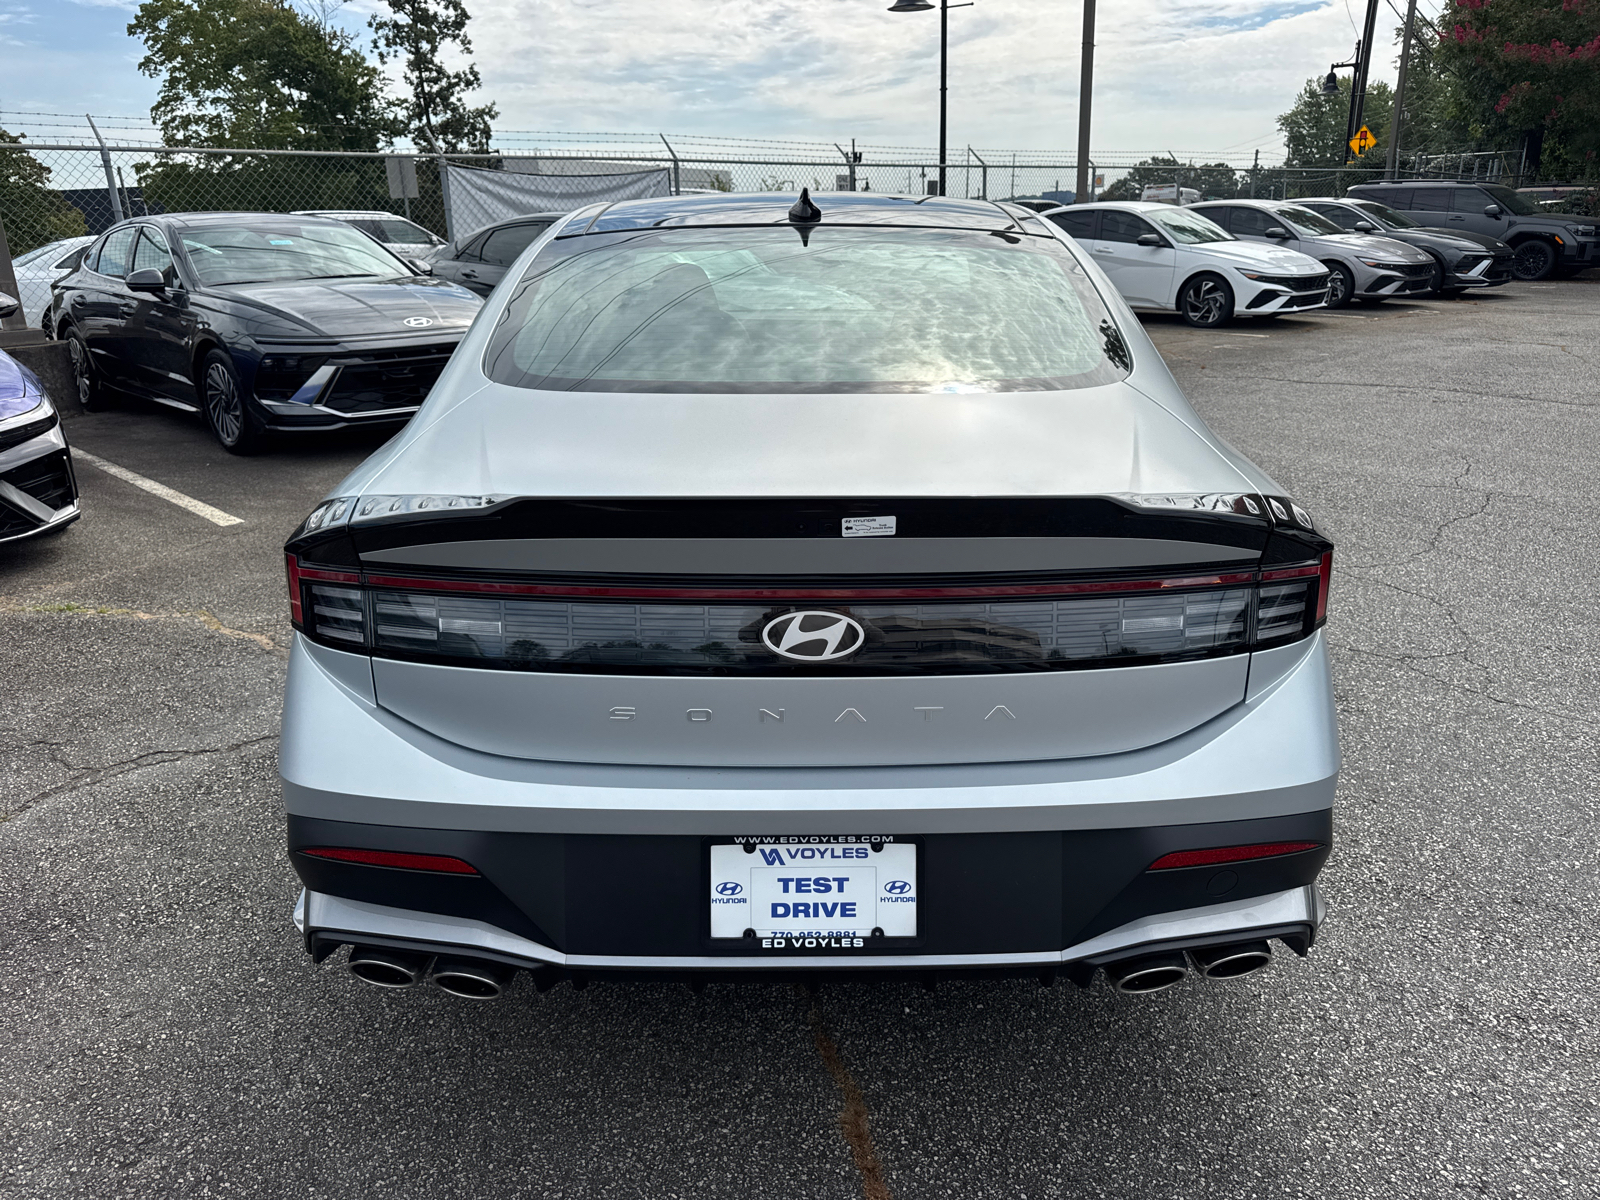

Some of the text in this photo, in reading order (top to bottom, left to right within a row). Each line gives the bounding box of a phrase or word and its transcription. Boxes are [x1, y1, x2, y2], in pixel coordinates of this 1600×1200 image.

[609, 705, 1016, 723] SONATA
[786, 847, 869, 859] VOYLES
[777, 877, 850, 893] TEST
[771, 902, 857, 918] DRIVE
[762, 938, 864, 948] ED VOYLES
